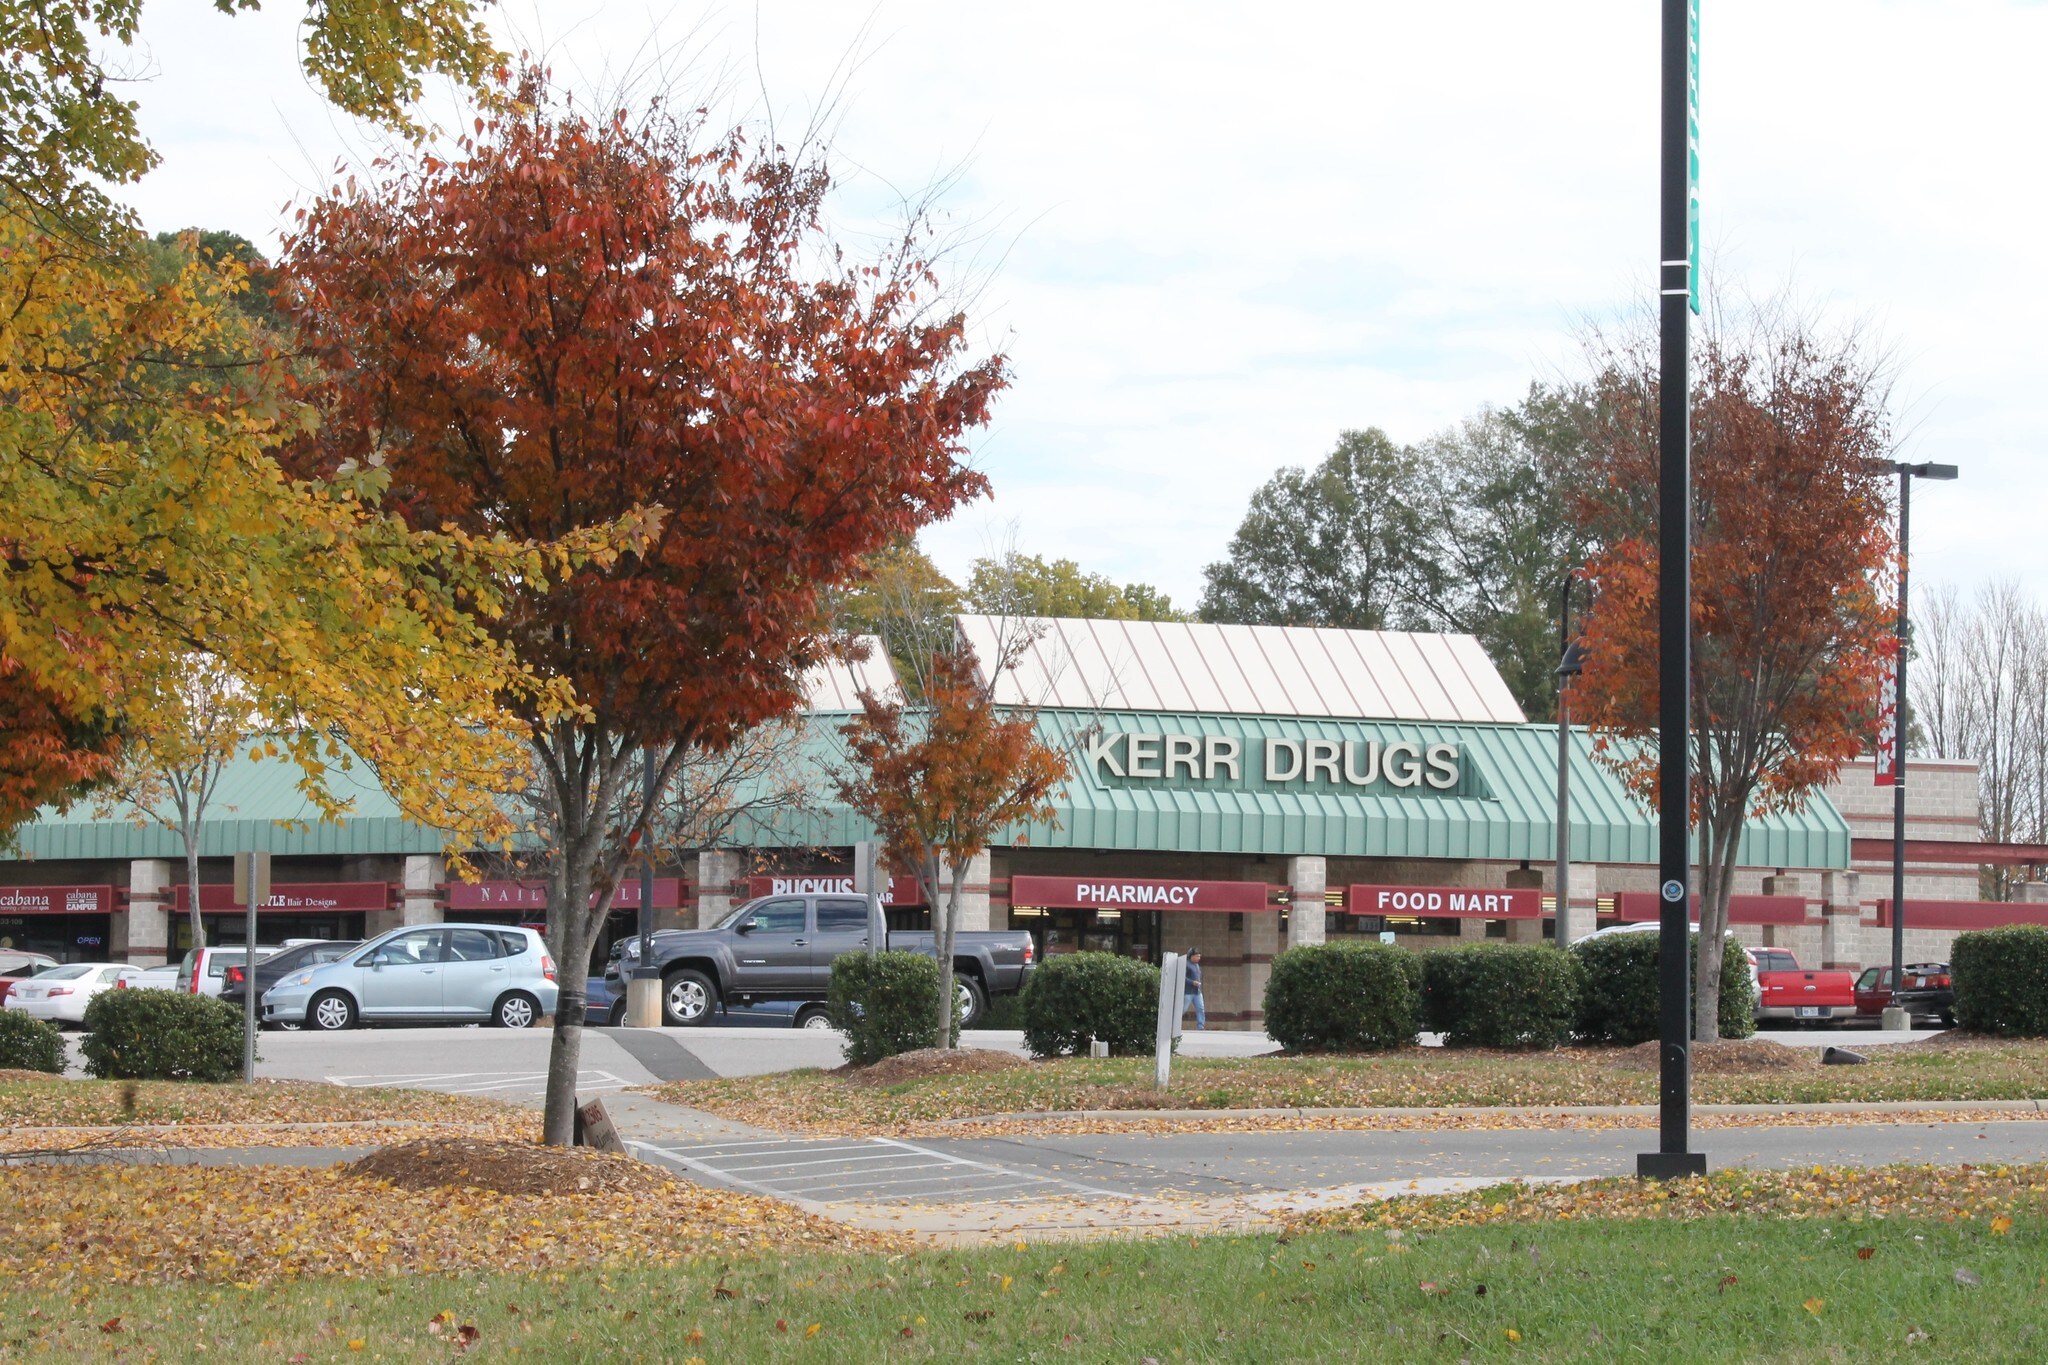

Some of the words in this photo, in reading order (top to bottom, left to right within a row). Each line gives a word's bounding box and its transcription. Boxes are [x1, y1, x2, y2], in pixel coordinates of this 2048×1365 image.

[1089, 733, 1240, 781] KERR
[1265, 737, 1460, 790] DRUGS
[66, 889, 97, 898] cabana
[772, 878, 854, 895] RUCKUS
[1077, 884, 1199, 904] PHARMACY
[0, 889, 49, 905] cabana
[287, 898, 302, 906] Hair
[305, 898, 337, 908] Designs
[1378, 892, 1442, 910] FOOD
[1450, 894, 1513, 912] MART
[66, 903, 97, 911] CAMPUS
[77, 936, 101, 944] OPEN
